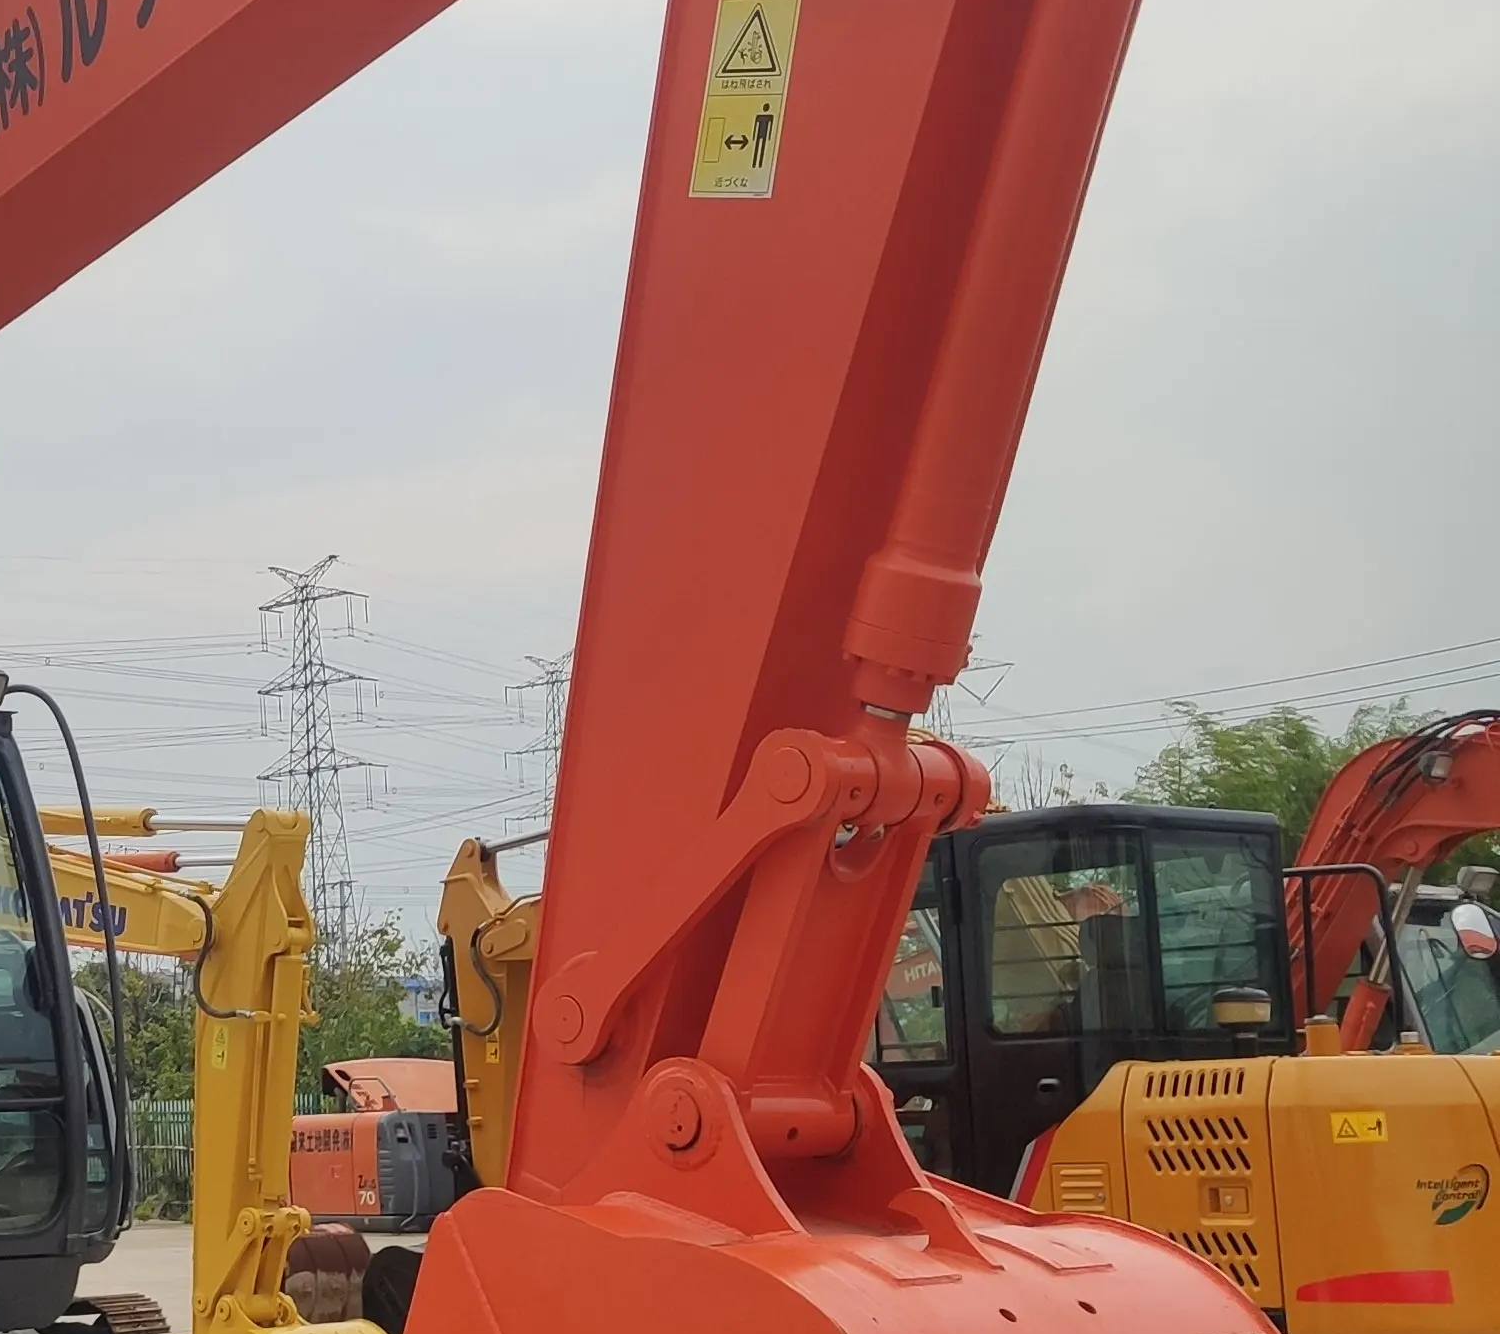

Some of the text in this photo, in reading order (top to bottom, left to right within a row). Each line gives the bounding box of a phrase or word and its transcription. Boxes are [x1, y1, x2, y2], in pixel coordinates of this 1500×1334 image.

[713, 176, 749, 188] 近づくな
[903, 960, 942, 984] HITA
[357, 1190, 377, 1206] 70
